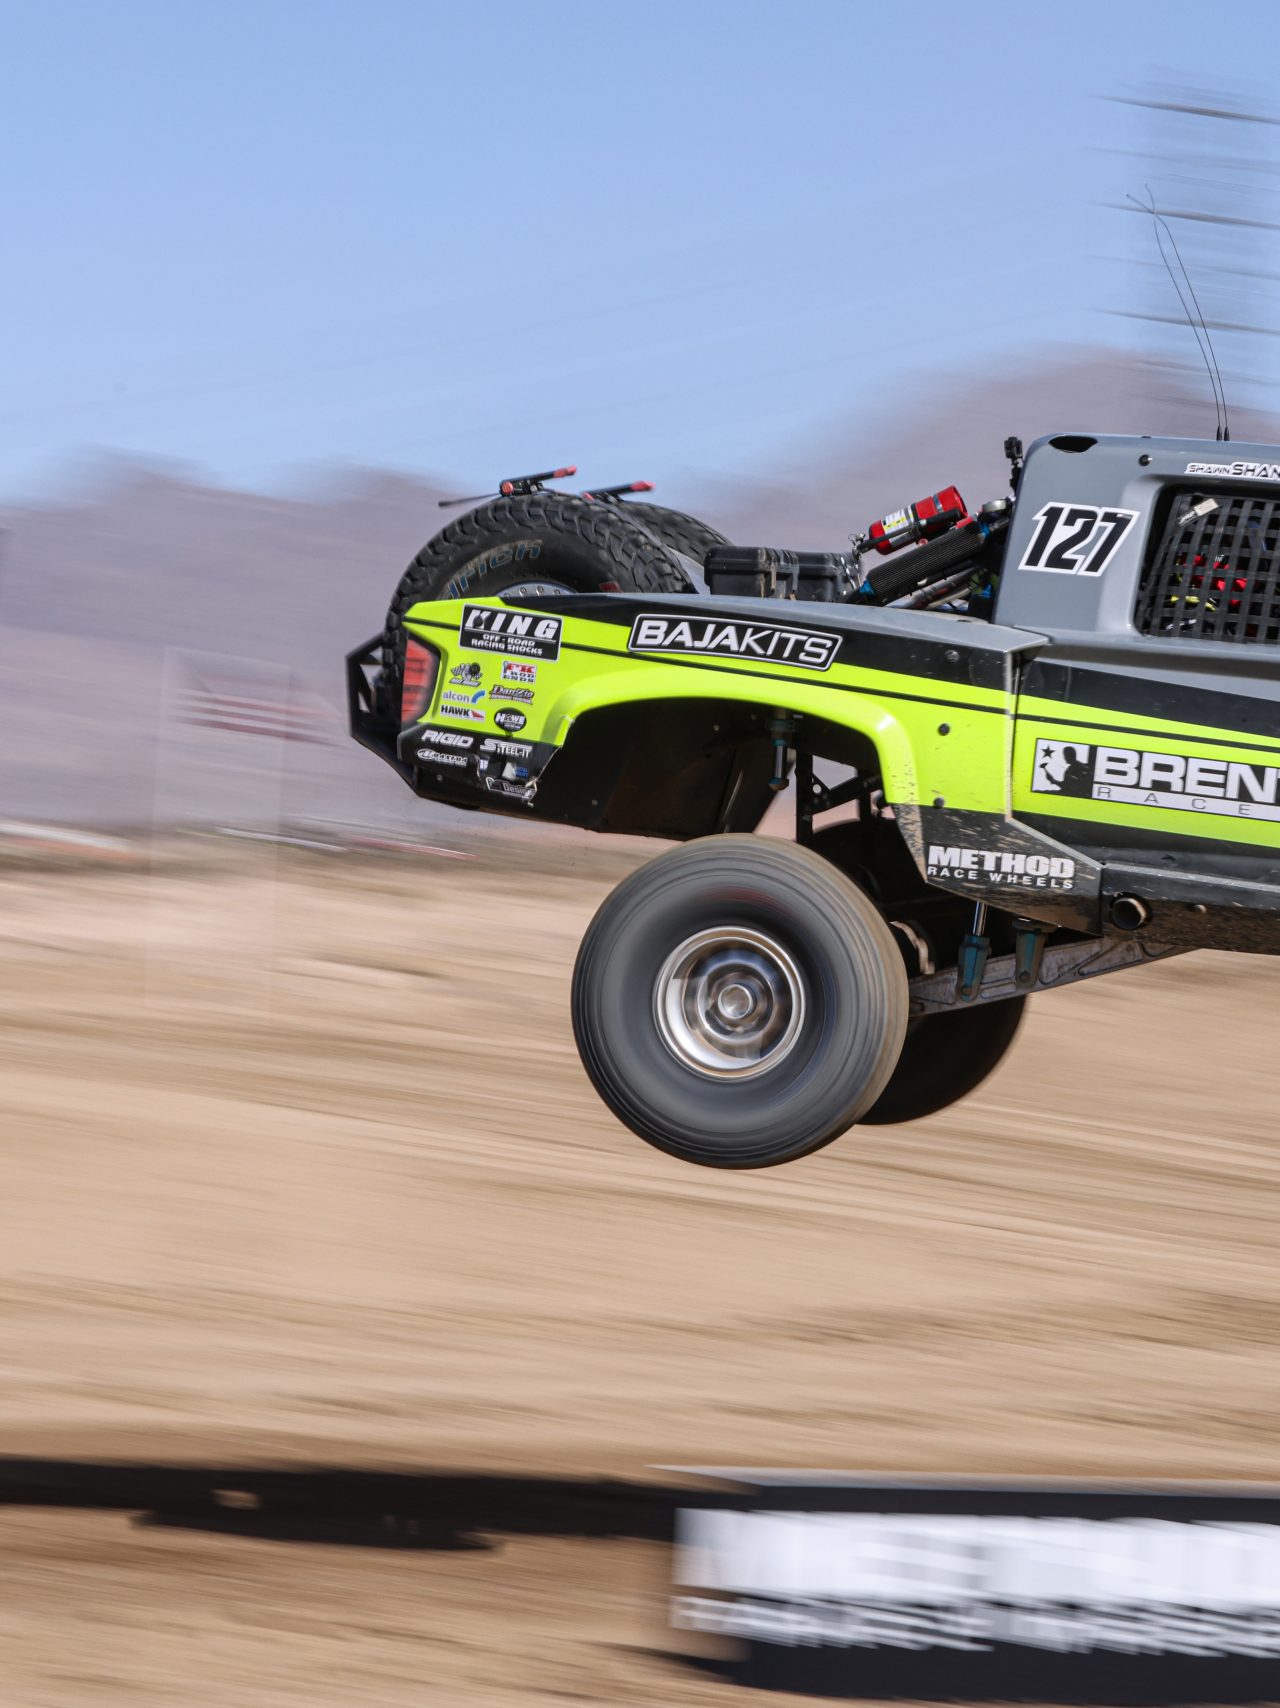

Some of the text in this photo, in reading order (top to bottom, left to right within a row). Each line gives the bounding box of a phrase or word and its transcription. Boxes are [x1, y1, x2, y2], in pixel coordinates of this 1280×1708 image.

[1189, 464, 1230, 474] SHAWN
[1021, 503, 1138, 575] 127
[465, 609, 559, 639] KING
[471, 639, 543, 656] RACING SHOCKS
[636, 620, 833, 664] BAJAKITS
[443, 690, 470, 702] alcon
[441, 705, 470, 717] HAWK
[421, 730, 474, 749] RIGID
[928, 845, 1075, 878] METHOD
[928, 866, 1074, 889] RACE WHEELS
